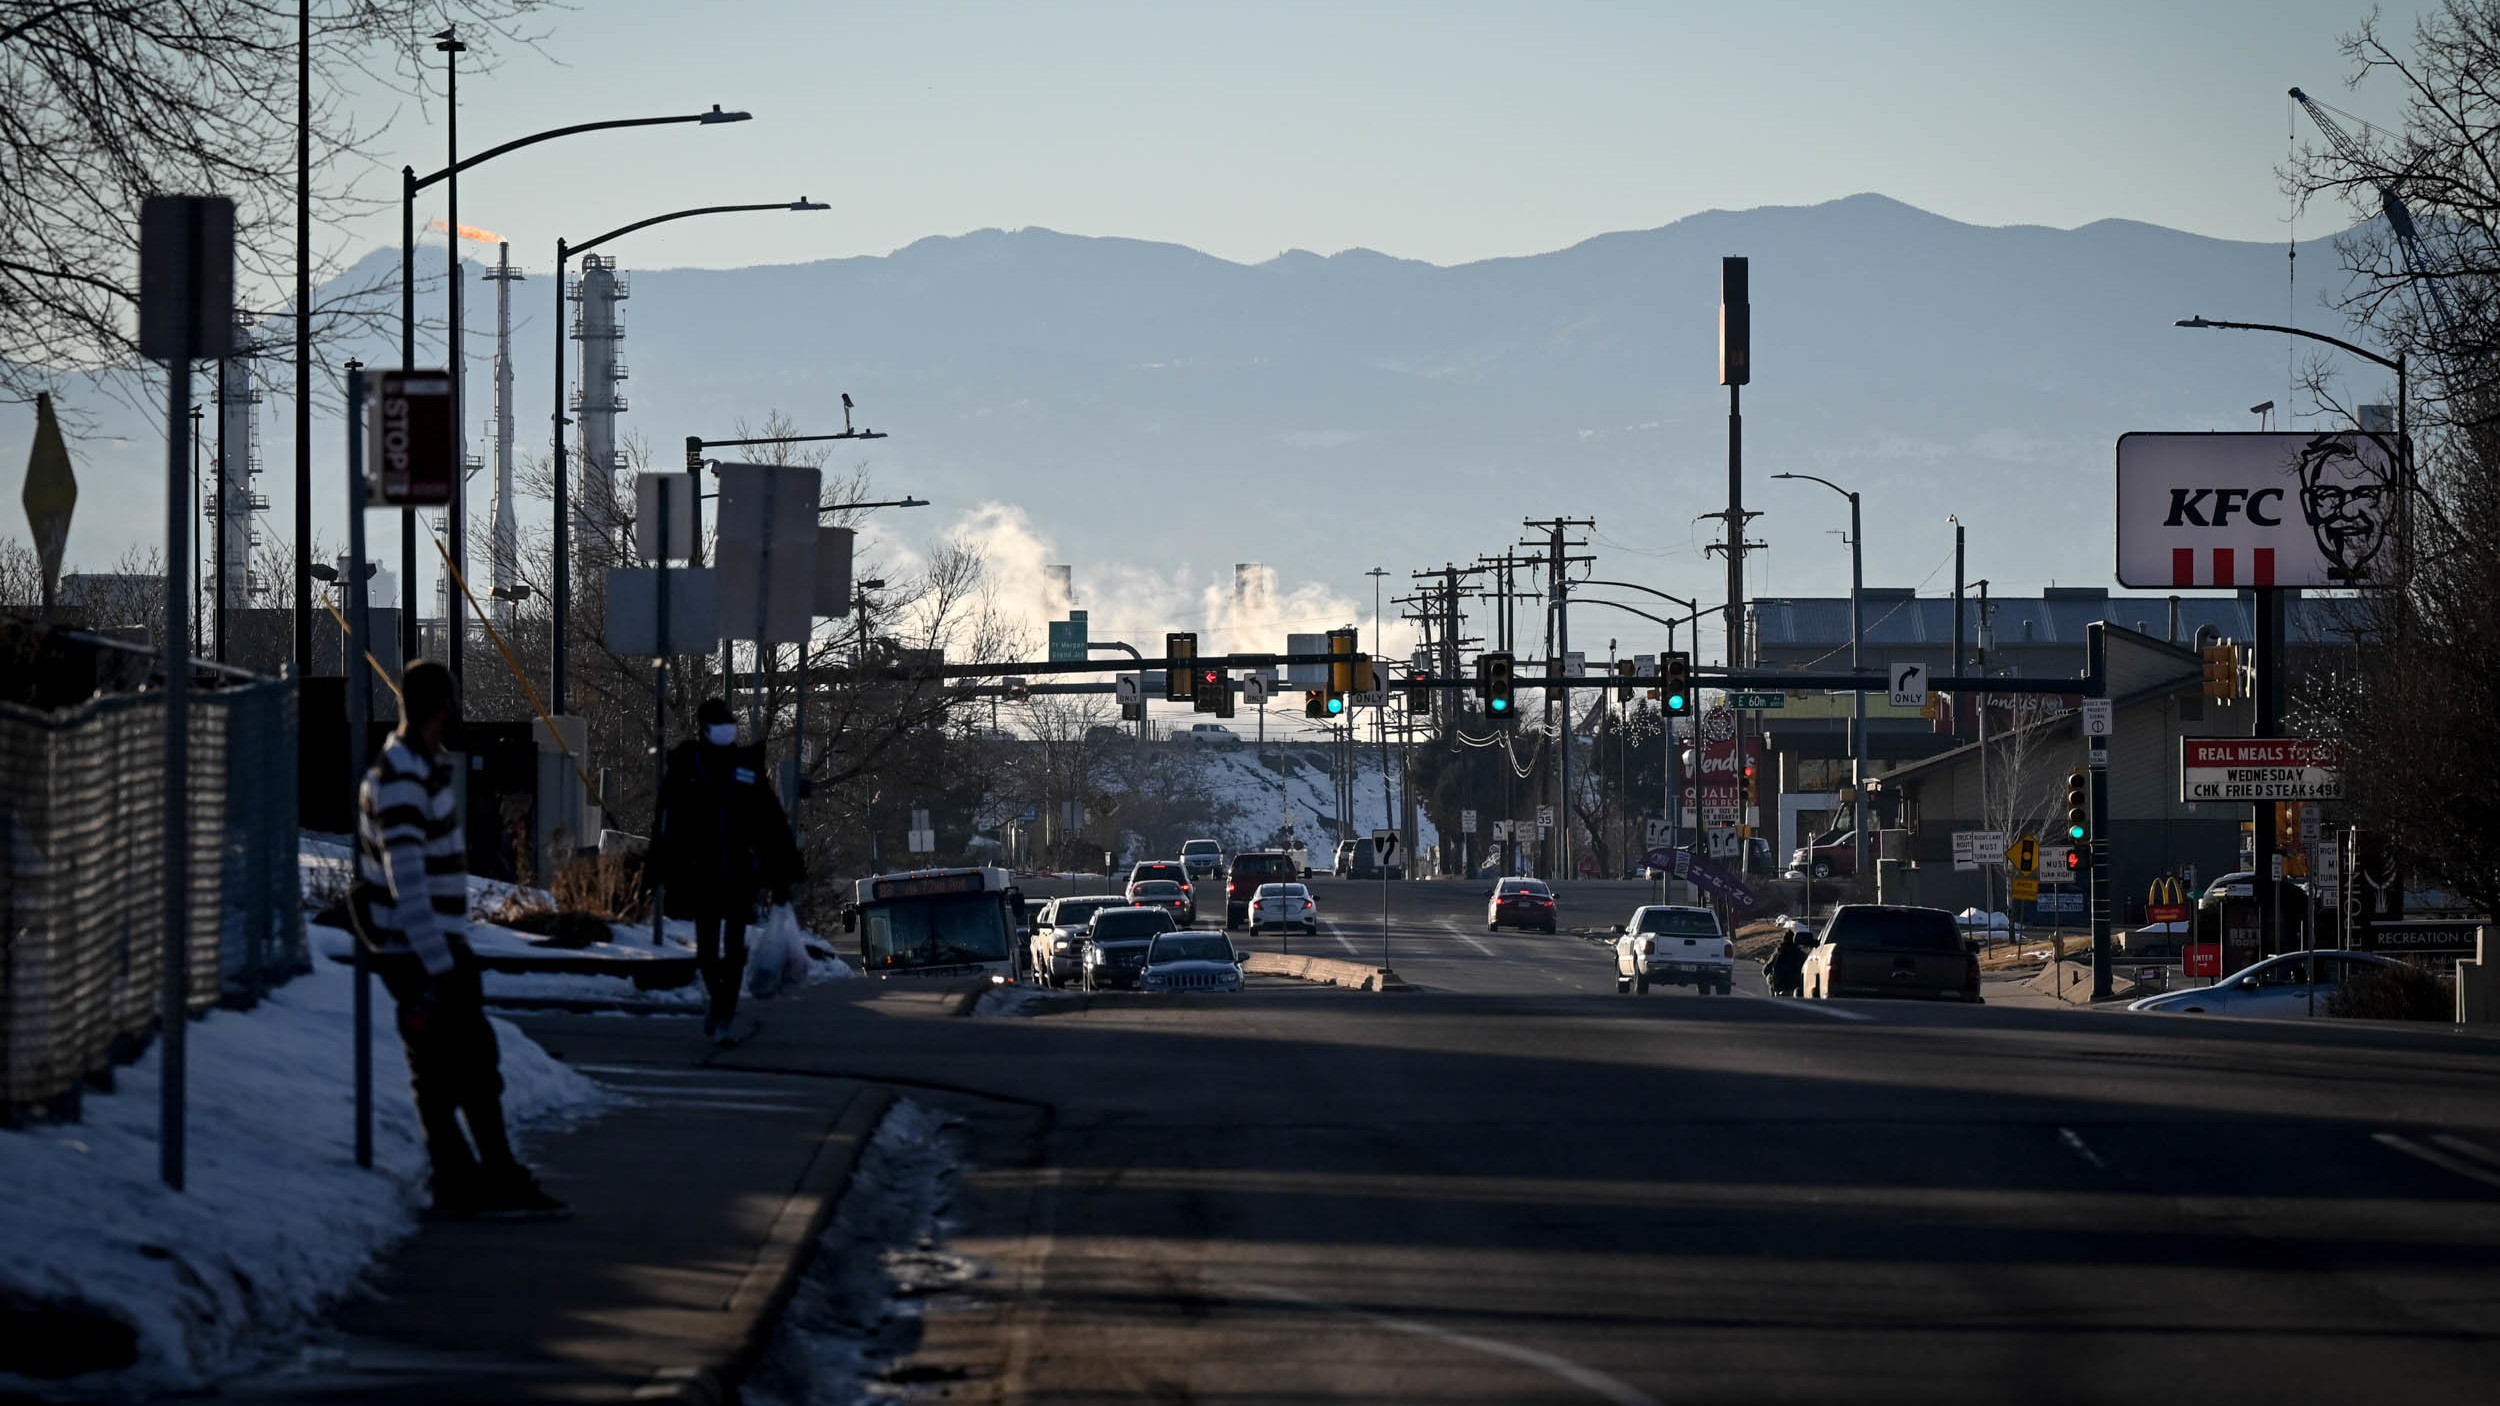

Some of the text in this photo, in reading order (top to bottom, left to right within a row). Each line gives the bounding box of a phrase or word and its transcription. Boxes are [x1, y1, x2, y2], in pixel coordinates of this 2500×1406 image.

[384, 397, 410, 470] STOP
[2163, 488, 2284, 526] KFC
[1356, 693, 1383, 703] ONLY
[1738, 696, 1744, 707] E
[1895, 693, 1922, 703] ONLY
[2198, 747, 2234, 761] REAL
[2238, 747, 2283, 761] MEALS
[2227, 769, 2304, 782] WEDNESDAY
[2194, 784, 2219, 796] CHK
[2226, 784, 2263, 796] FRIED
[2266, 784, 2306, 797] STEAK
[1539, 816, 1552, 825] 35
[1980, 843, 1997, 851] MUST
[2320, 847, 2336, 855] RIGH
[2046, 860, 2067, 868] MUST
[2377, 932, 2459, 944] RECREATION
